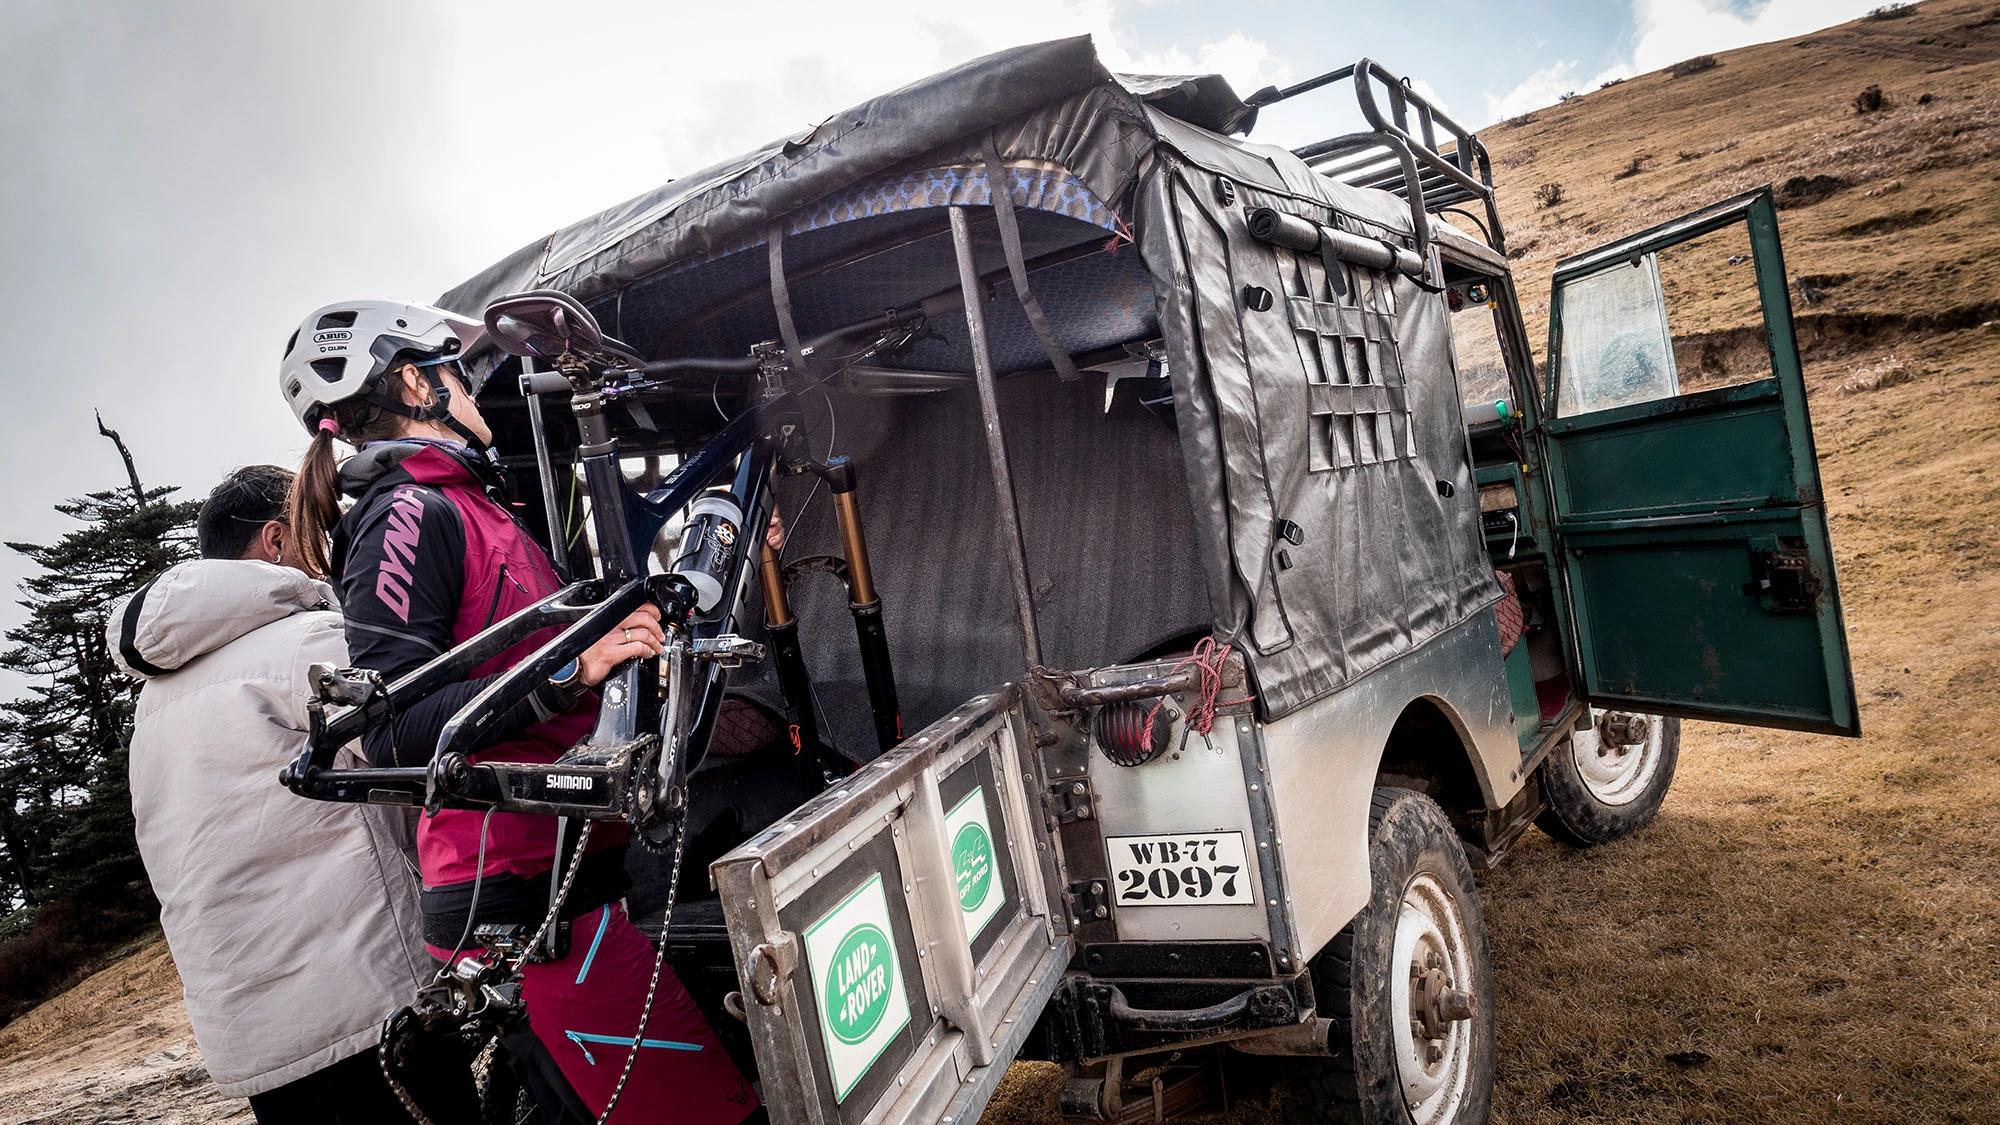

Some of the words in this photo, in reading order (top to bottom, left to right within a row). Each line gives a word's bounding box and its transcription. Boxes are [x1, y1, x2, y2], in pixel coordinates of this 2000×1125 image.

[318, 332, 348, 341] ABUS
[546, 774, 593, 790] SHIMANO
[1128, 839, 1219, 865] WB-77
[959, 881, 972, 901] OFF
[972, 863, 988, 887] ROAD
[1118, 865, 1240, 900] 2097
[837, 941, 871, 997] LAND
[846, 963, 887, 1027] ROVER
